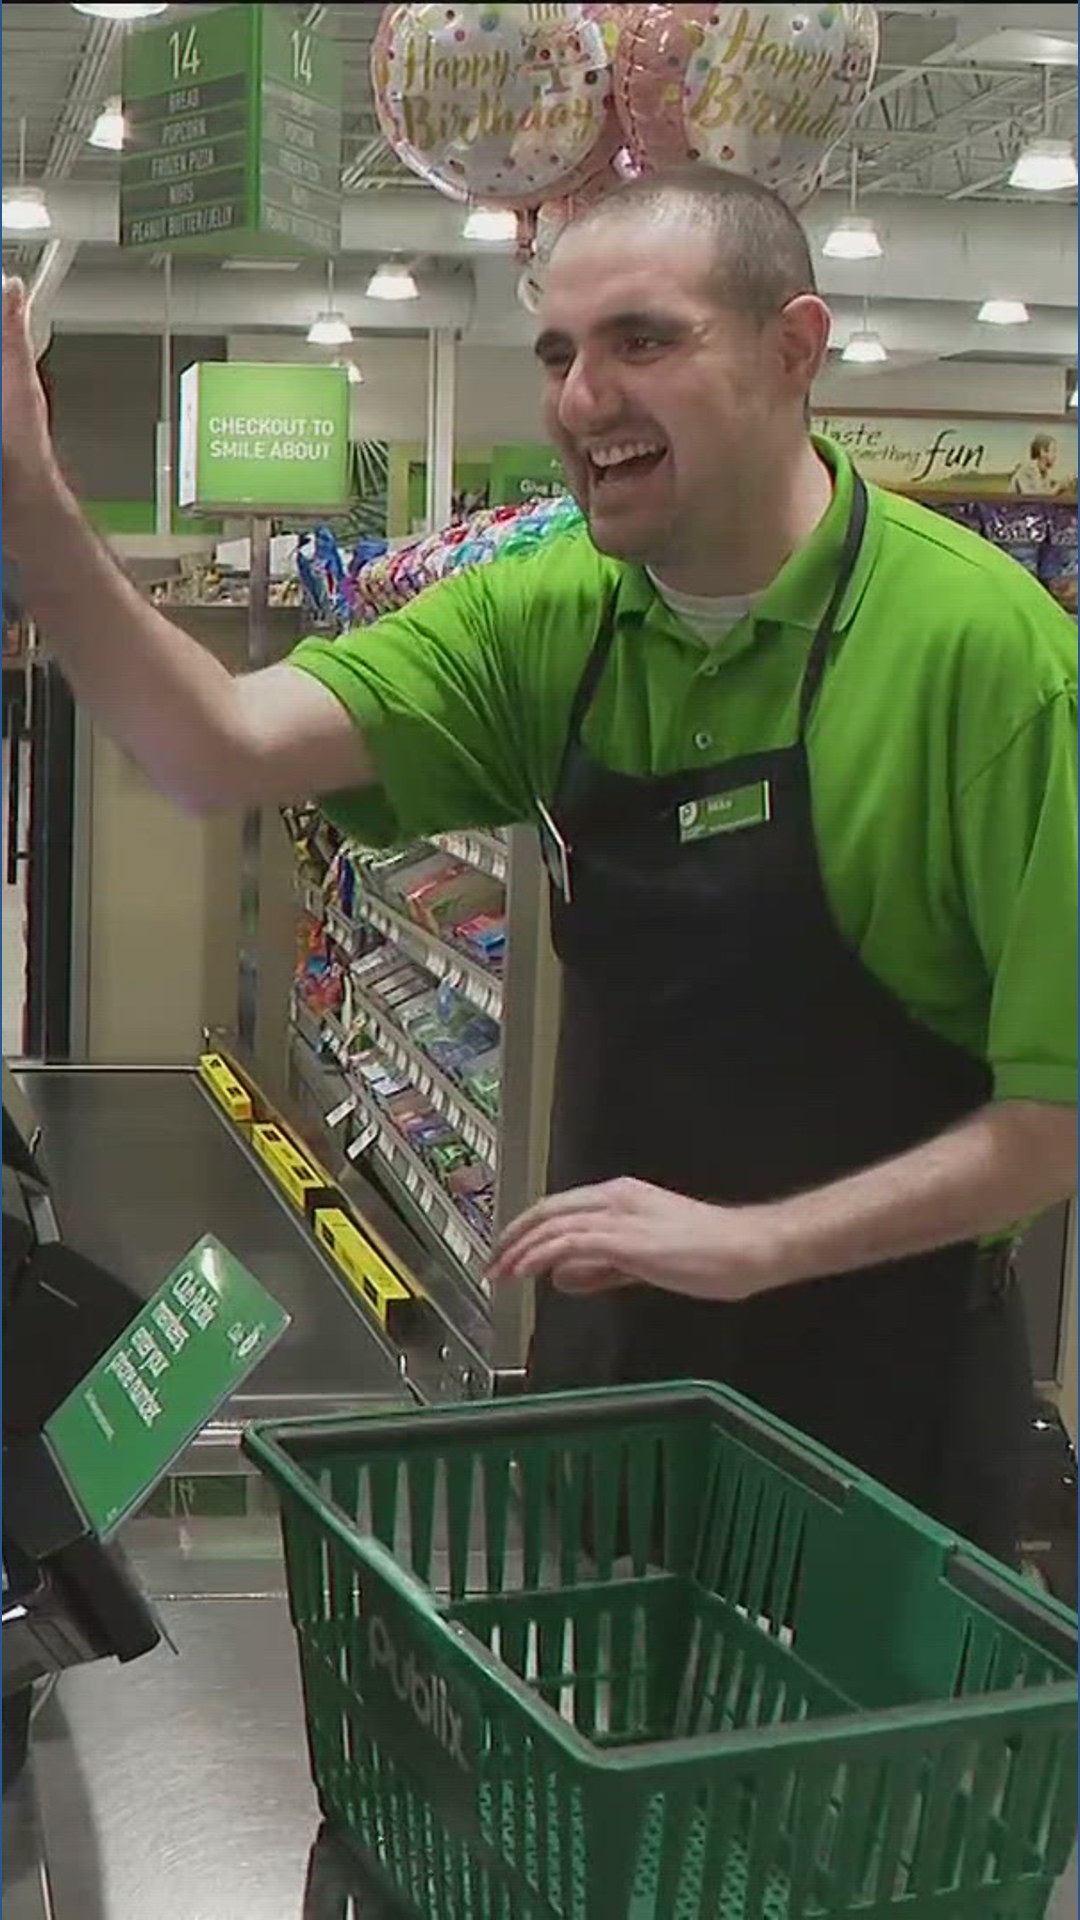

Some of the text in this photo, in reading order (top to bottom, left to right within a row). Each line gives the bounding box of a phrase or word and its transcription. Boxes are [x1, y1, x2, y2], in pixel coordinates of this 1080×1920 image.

[169, 25, 201, 80] 14
[291, 29, 313, 85] 14
[404, 32, 511, 90] Happy
[722, 7, 832, 89] Happy
[208, 416, 335, 437] CHECKOUT TO
[209, 440, 332, 461] SMILE ABOUT
[911, 428, 985, 483] fun
[368, 1615, 470, 1773] Publix
